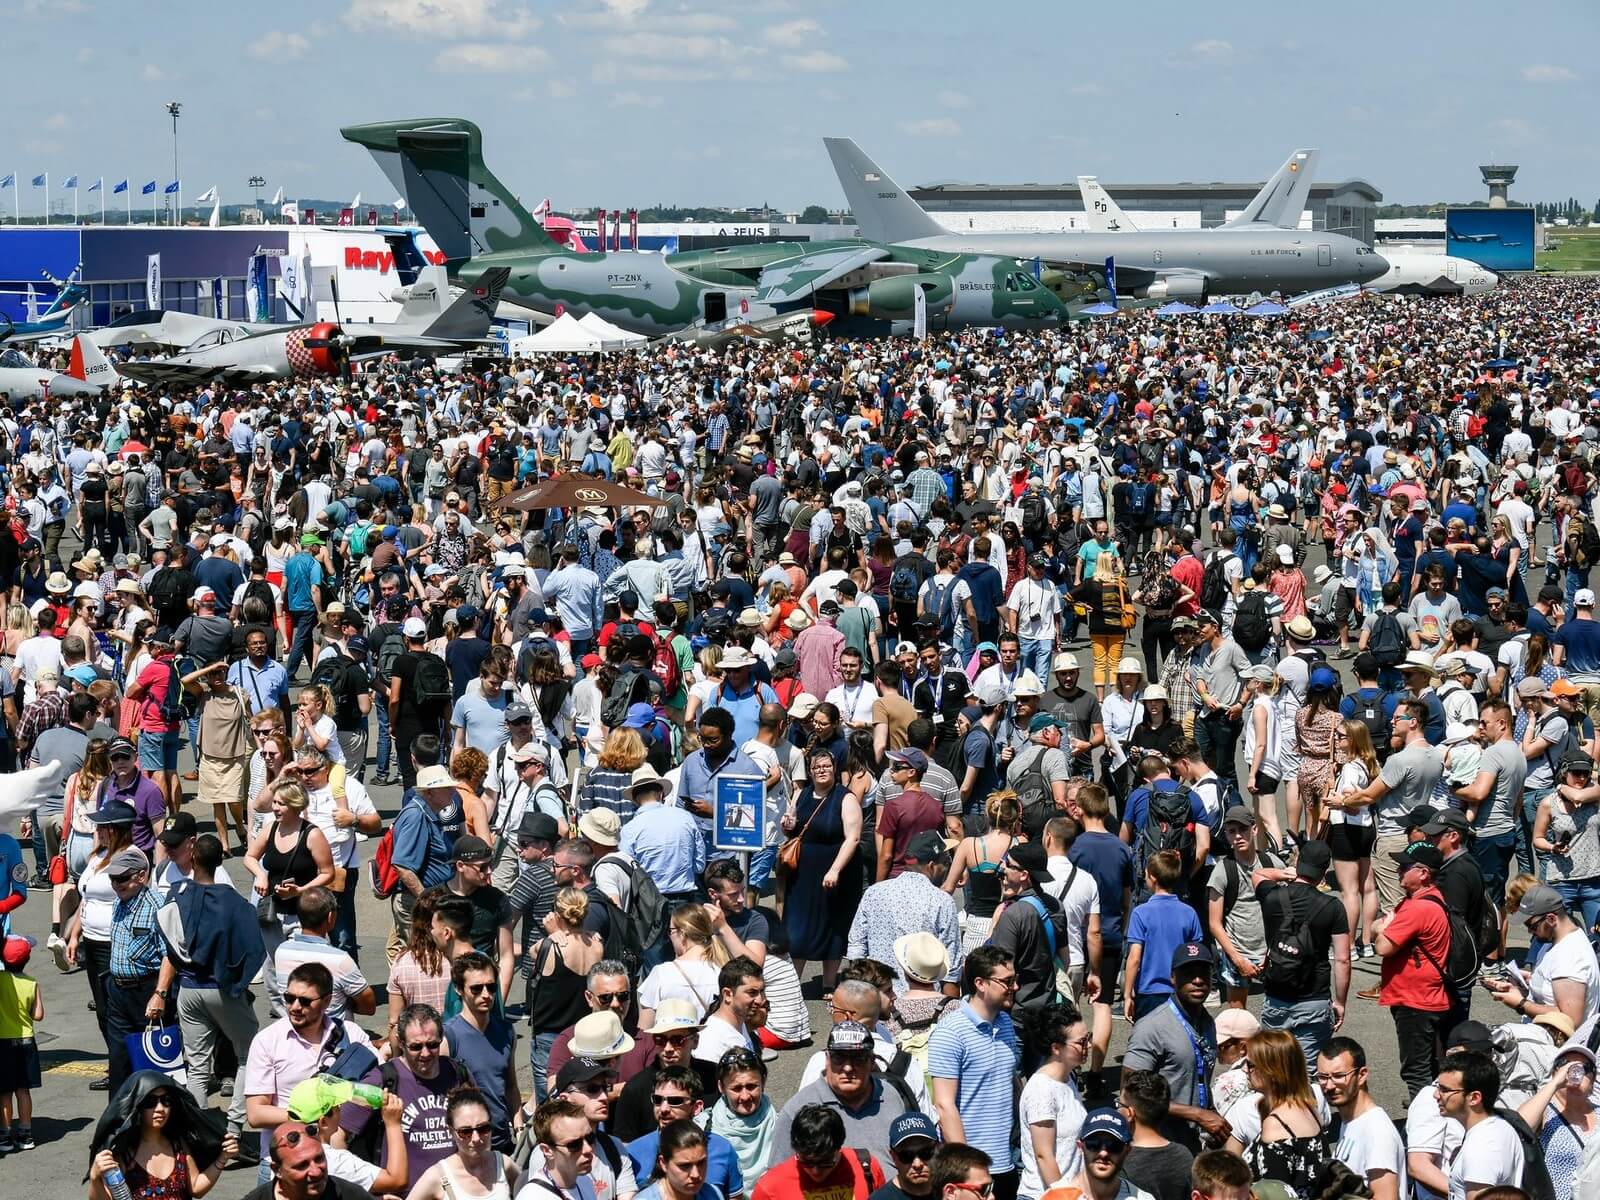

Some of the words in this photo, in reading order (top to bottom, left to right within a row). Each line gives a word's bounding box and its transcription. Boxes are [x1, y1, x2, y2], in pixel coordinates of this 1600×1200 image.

[1094, 201, 1107, 213] PD
[608, 274, 642, 282] PT-ZNX
[409, 1131, 447, 1143] ATHLETIC
